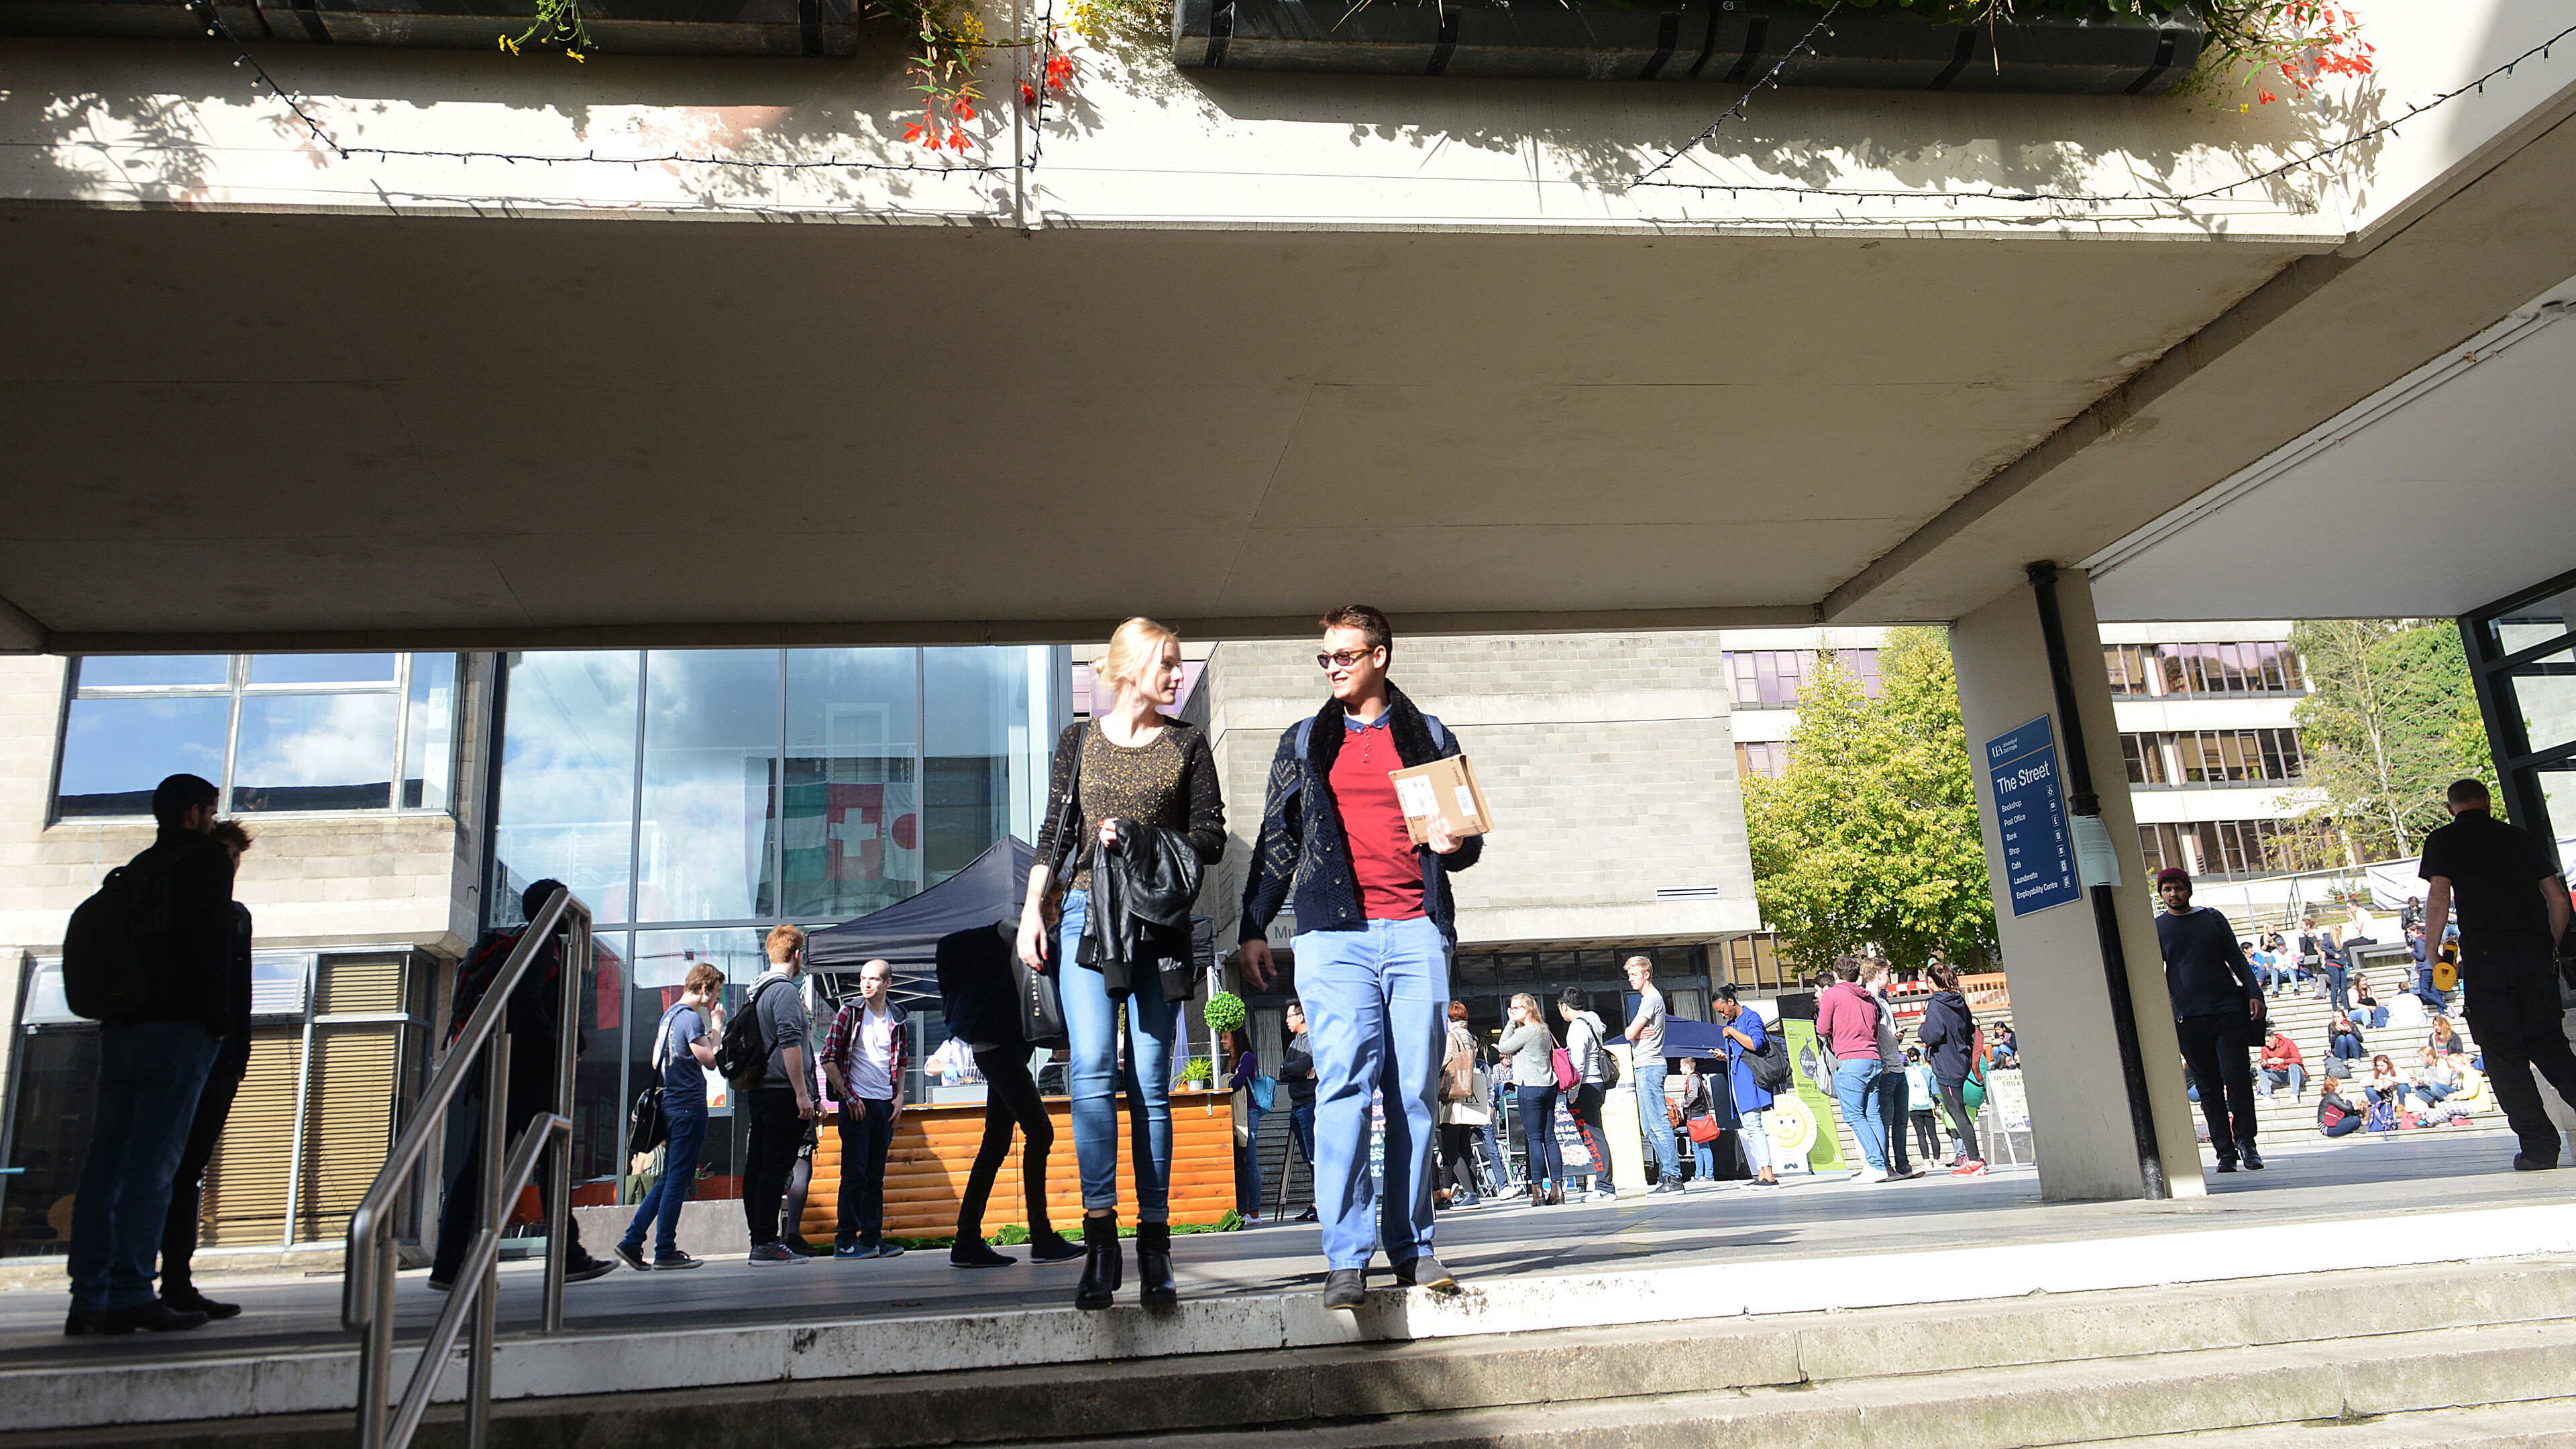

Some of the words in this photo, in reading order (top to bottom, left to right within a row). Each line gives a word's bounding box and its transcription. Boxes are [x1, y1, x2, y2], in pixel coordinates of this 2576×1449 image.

[1991, 745, 2004, 758] UEA
[1997, 777, 2017, 795] The
[2018, 760, 2050, 786] Street
[2001, 800, 2022, 812] Bookshop
[2004, 818, 2014, 827] Post
[2013, 814, 2026, 823] Office
[2006, 832, 2018, 841] Bank
[2008, 847, 2020, 856] Shop
[2014, 872, 2038, 885] Launderette
[2016, 885, 2043, 900] Employability
[2043, 881, 2058, 891] Centre
[1580, 1129, 1605, 1171] FITCH
